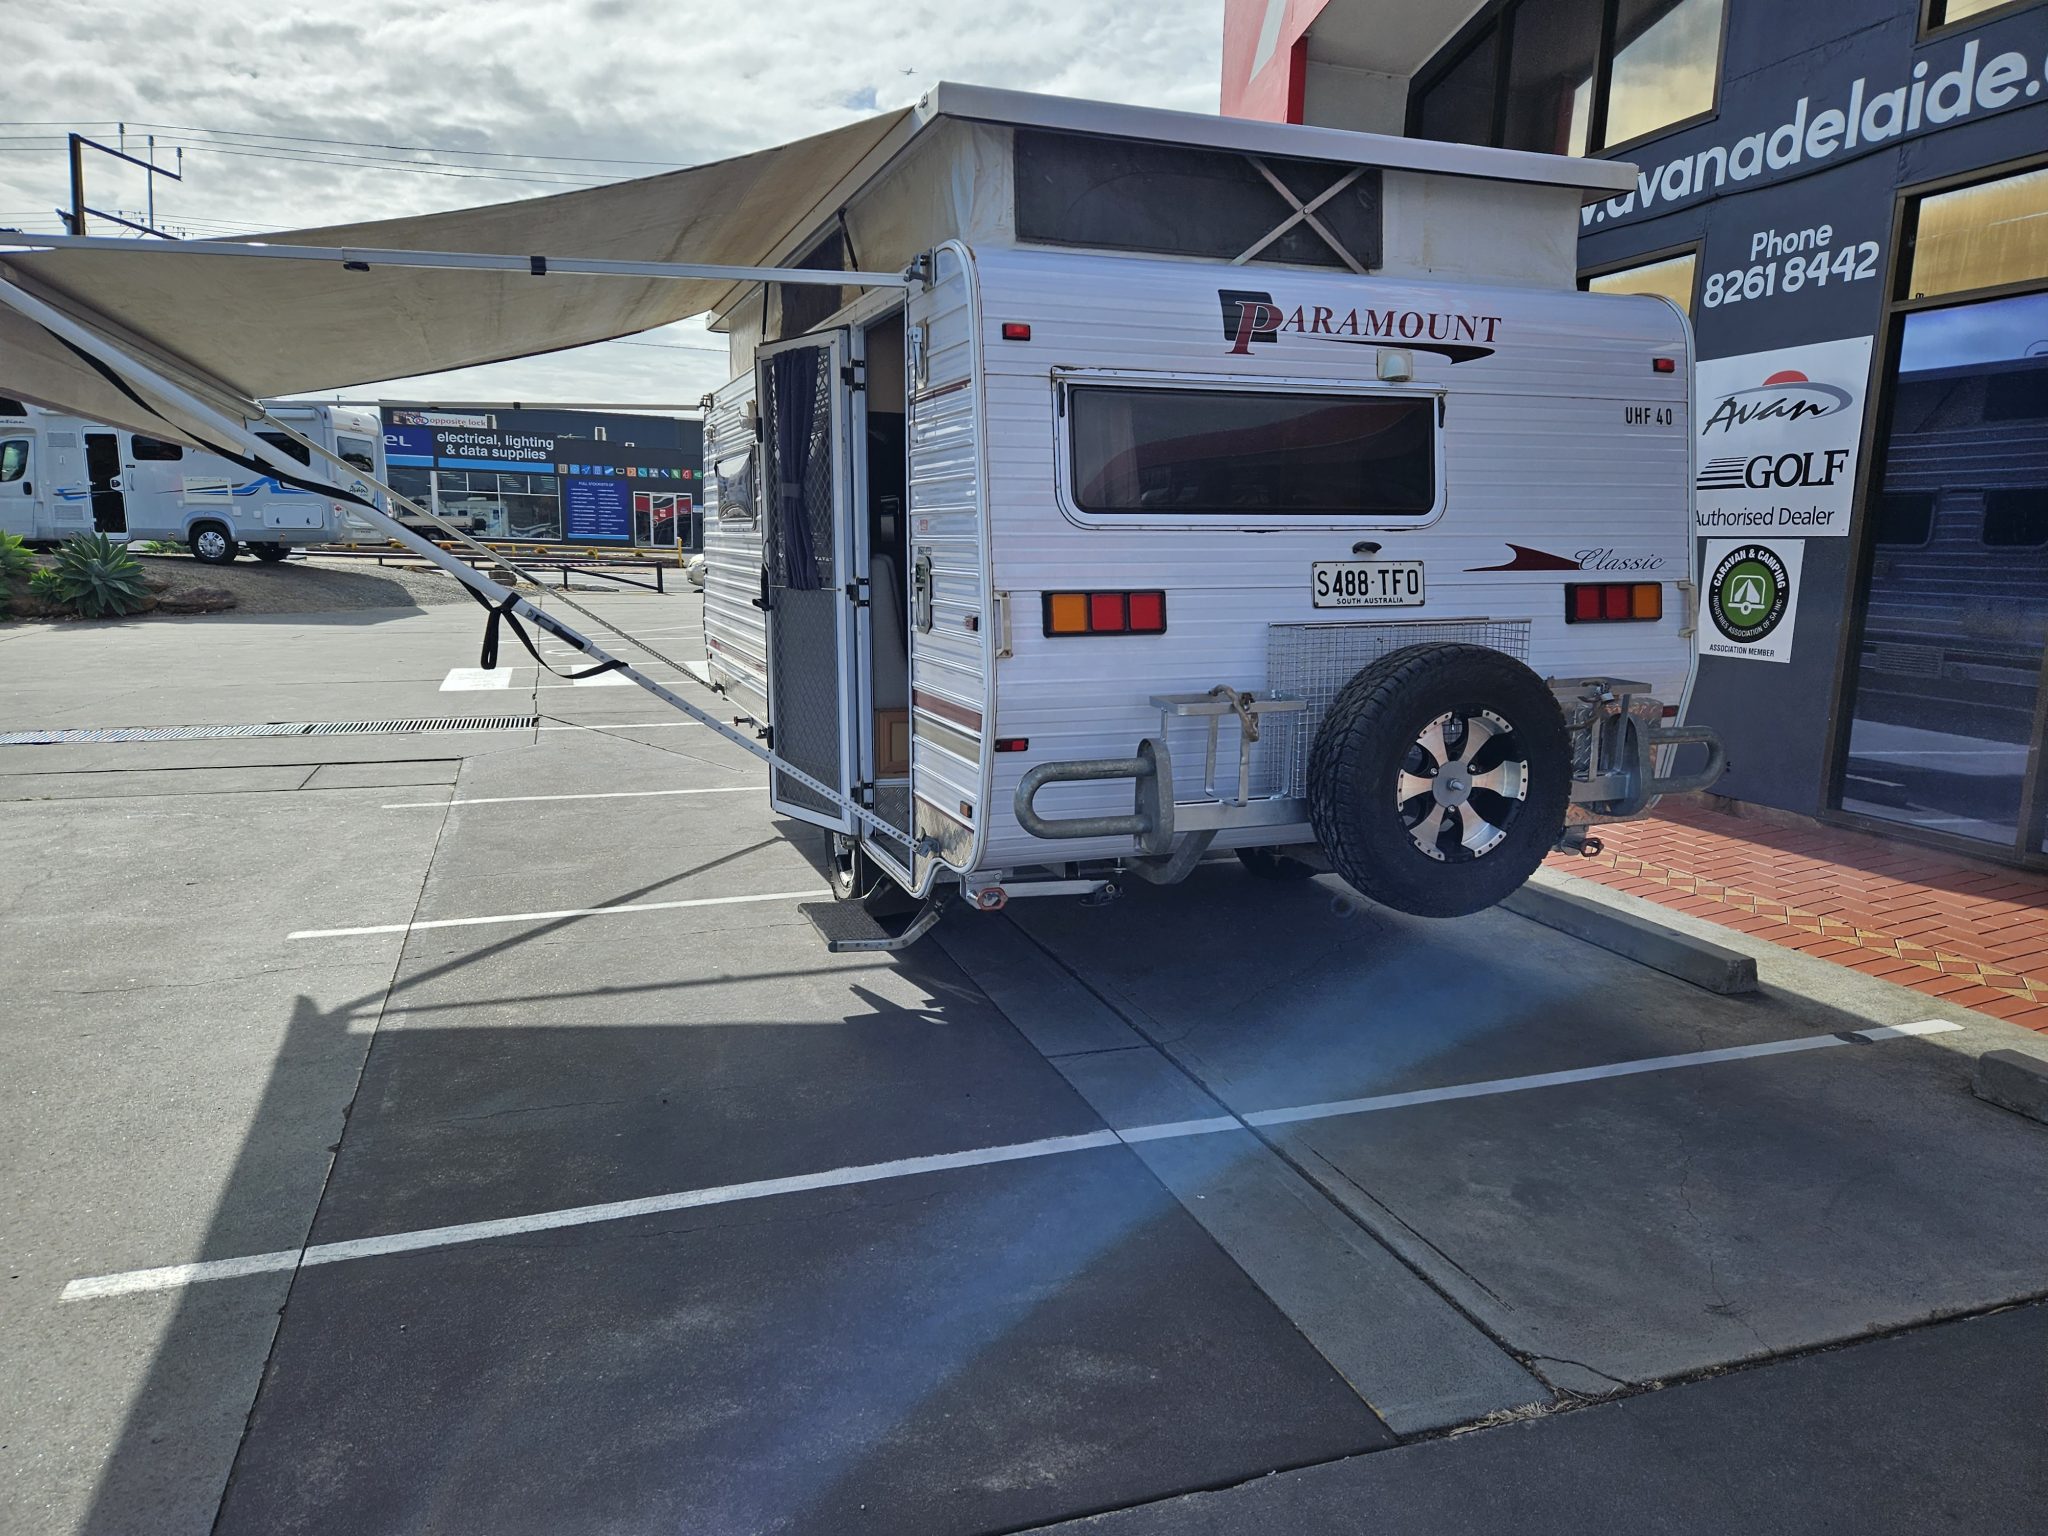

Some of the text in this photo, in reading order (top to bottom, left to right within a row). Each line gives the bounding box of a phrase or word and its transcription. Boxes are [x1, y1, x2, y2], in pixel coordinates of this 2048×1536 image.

[1750, 224, 1833, 262] Phone
[1703, 241, 1880, 308] 8261 8442
[1225, 300, 1502, 355] PARAMOUNT
[429, 417, 466, 426] opposite
[468, 418, 487, 427] lock
[1625, 406, 1673, 426] UHF 40
[1702, 396, 1829, 436] Avan
[437, 431, 554, 451] electrical, lighting
[446, 444, 546, 460] & data supplies
[1745, 449, 1850, 489] GOLF
[1779, 505, 1835, 525] Dealer
[1574, 547, 1667, 570] Classic
[1713, 548, 1786, 589] CARAVAN & CAMPING
[1713, 595, 1729, 629] INDUSTRIES
[1728, 625, 1763, 637] ASSOCIATION
[1762, 619, 1772, 629] OF
[1769, 611, 1778, 622] SA
[1709, 643, 1775, 657] ASSOCIATION MEMBER
